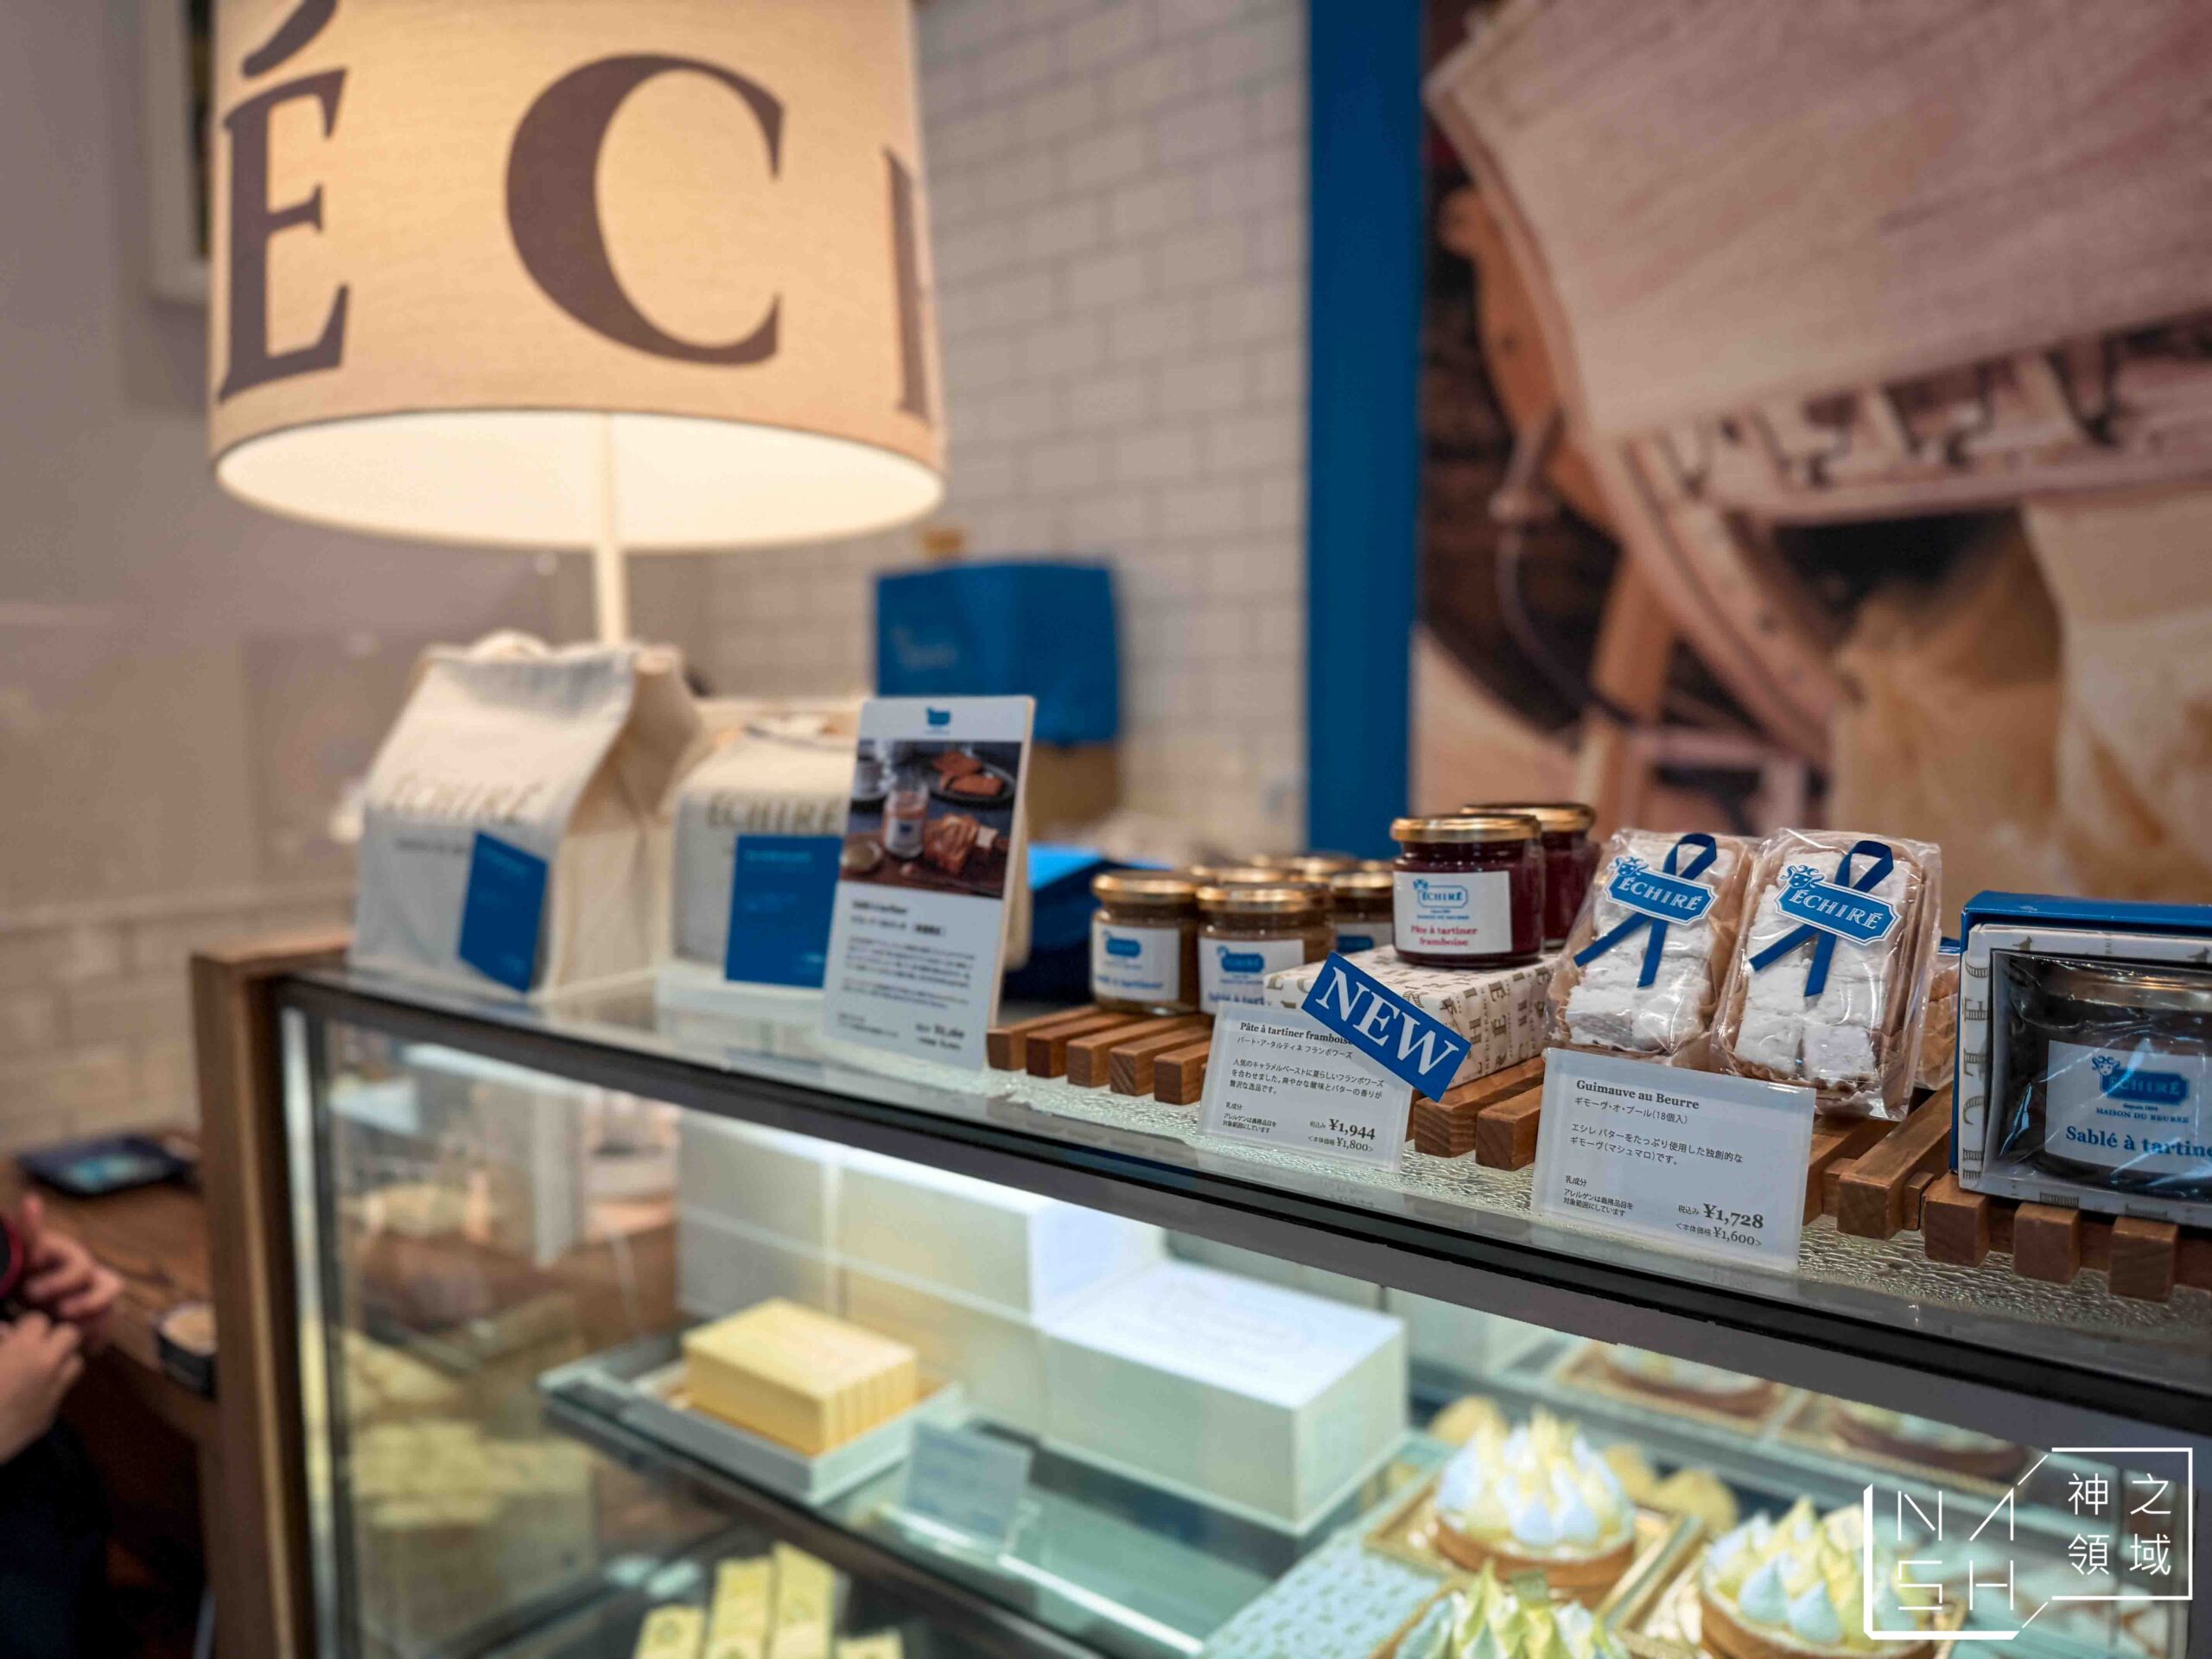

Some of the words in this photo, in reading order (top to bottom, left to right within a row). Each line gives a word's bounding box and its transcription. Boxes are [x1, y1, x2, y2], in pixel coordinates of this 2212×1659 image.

[1617, 874, 1703, 912] ÉCHIRÉ
[1788, 887, 1882, 931] ÉCHIRÉ
[1419, 937, 1468, 947] framboise
[1438, 925, 1478, 935] tartiner
[1240, 1022, 1259, 1033] Pâte
[1261, 1024, 1266, 1033] à
[1268, 1025, 1305, 1039] tartiner
[1315, 966, 1459, 1077] NEW
[1576, 1079, 1637, 1100] Guimauve
[1638, 1091, 1653, 1102] au
[1656, 1093, 1700, 1110] Beurre
[2095, 1107, 2131, 1119] MAISON
[2133, 1112, 2147, 1121] DU
[2150, 1114, 2189, 1124] BEURRE
[1329, 1118, 1376, 1141] ¥1,944
[2066, 1125, 2118, 1147] Sablé
[2124, 1135, 2136, 1151] à
[1565, 1175, 1587, 1187] 乳成分
[1678, 1205, 1700, 1216] 税込み
[1703, 1203, 1764, 1229] ¥1,728
